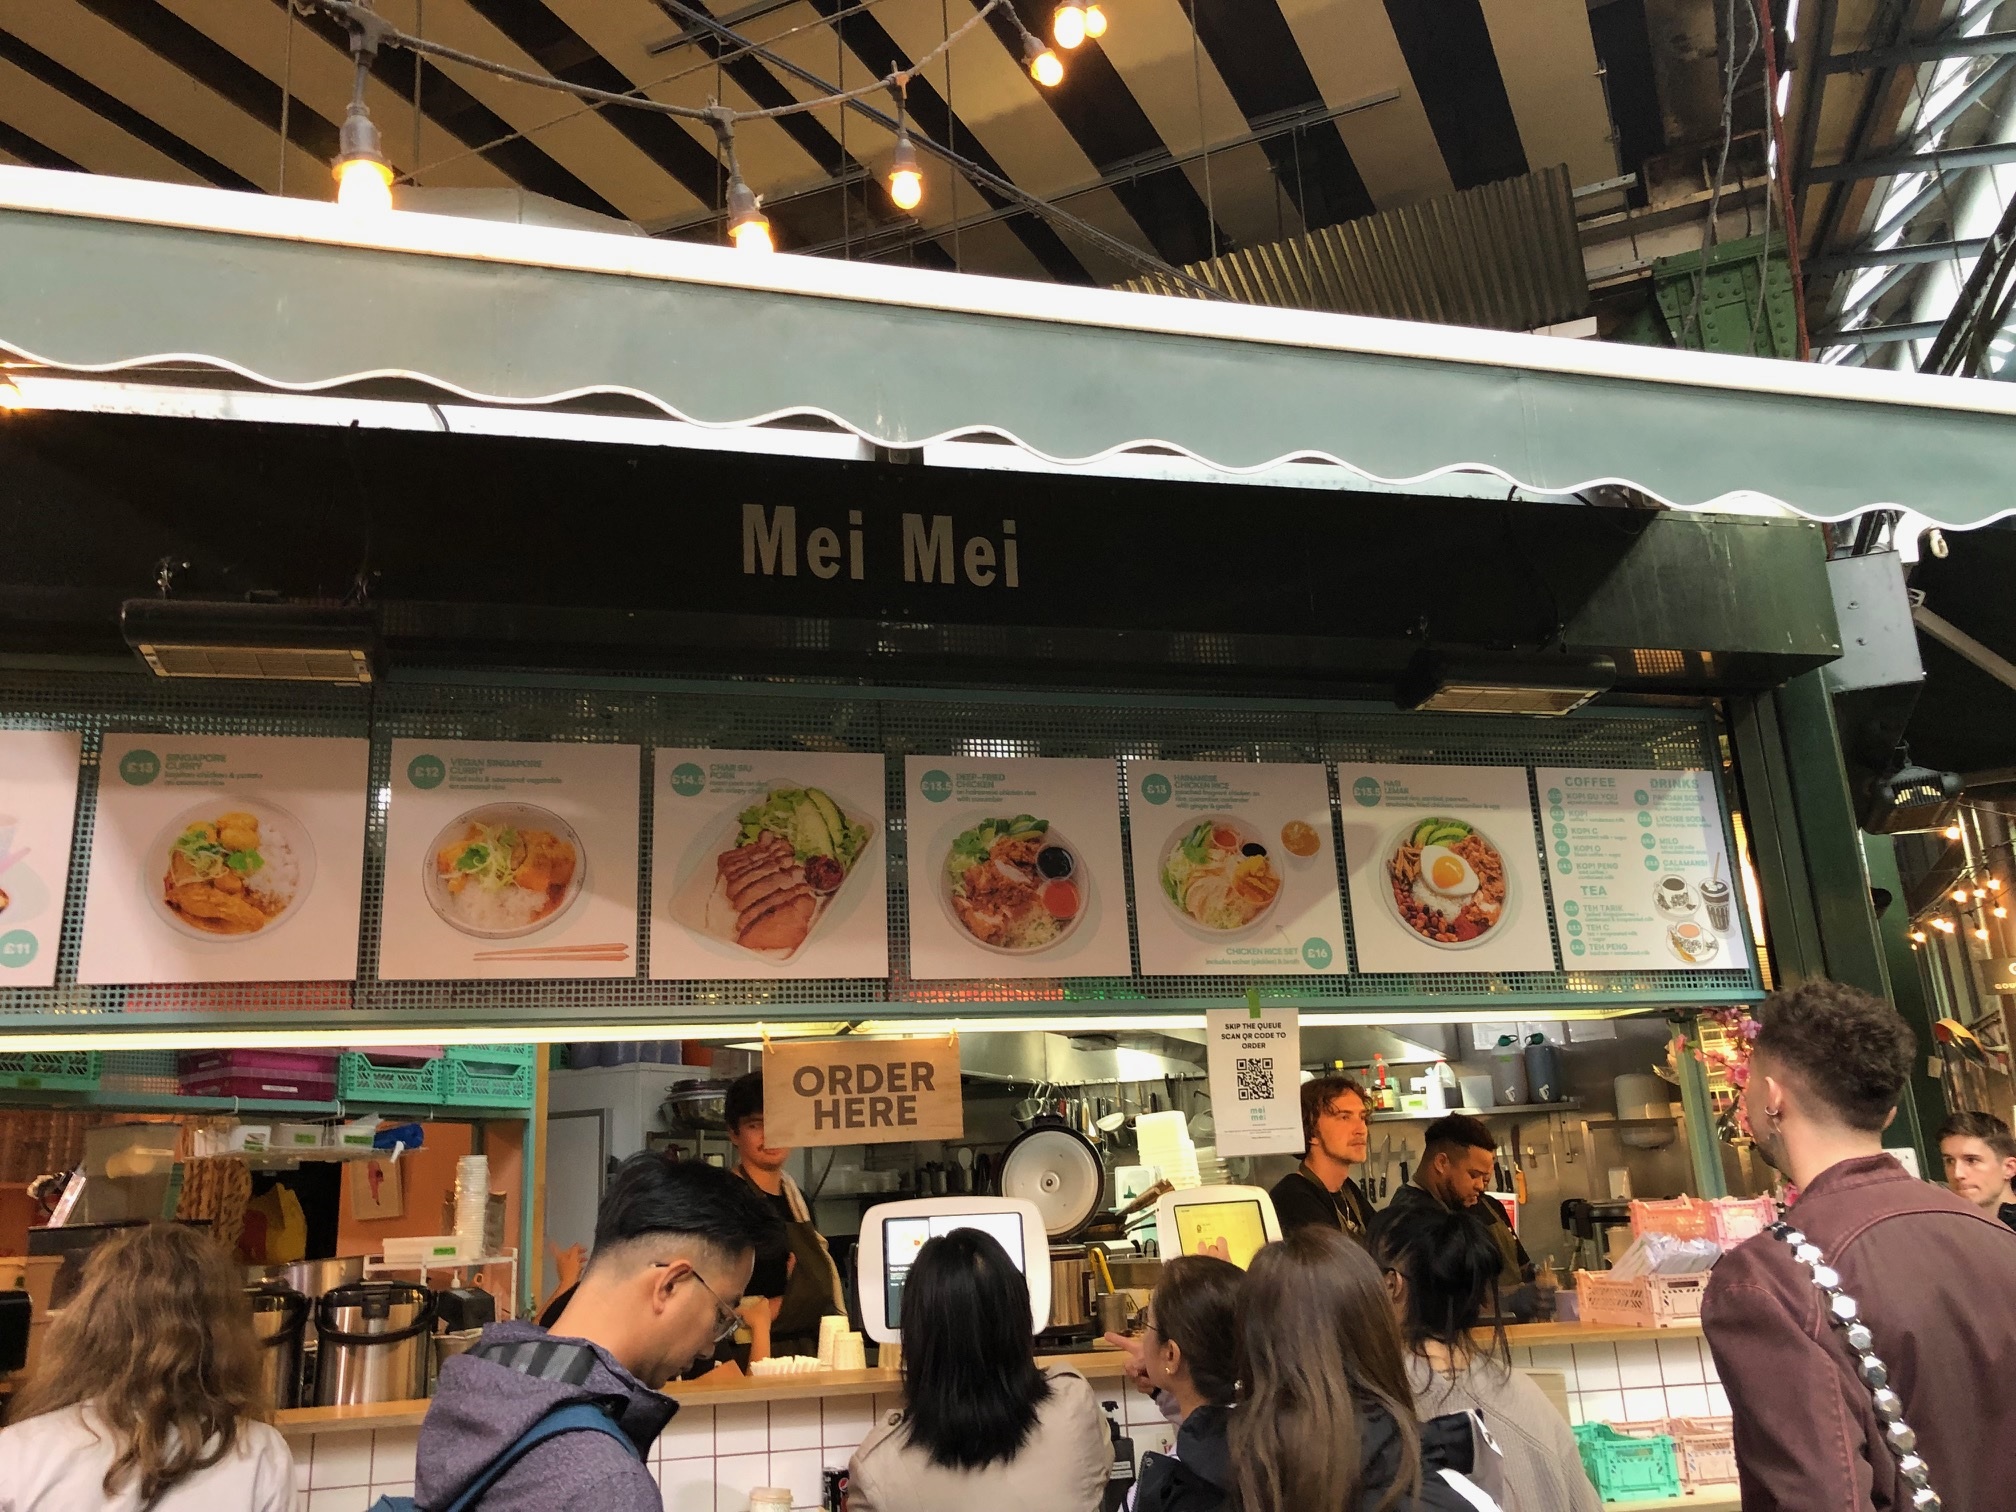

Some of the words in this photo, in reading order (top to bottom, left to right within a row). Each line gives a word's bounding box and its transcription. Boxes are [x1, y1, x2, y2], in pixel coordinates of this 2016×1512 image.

[742, 503, 864, 580] Mei
[902, 512, 1019, 588] Mei
[166, 754, 226, 762] SINGAPORE
[450, 758, 484, 766] VEGAN
[486, 760, 542, 768] SINGAPORE
[165, 762, 202, 770] CURRY
[921, 782, 952, 791] £13.5
[1564, 777, 1616, 787] COFFEE
[1650, 779, 1699, 789] DRINKS
[1580, 886, 1608, 896] TEA
[4, 943, 30, 954] £11
[1307, 948, 1328, 958] £16
[1257, 1022, 1282, 1030] QUEUE
[792, 1061, 936, 1097] ORDER
[814, 1095, 918, 1130] HERE
[1250, 1106, 1265, 1114] mei
